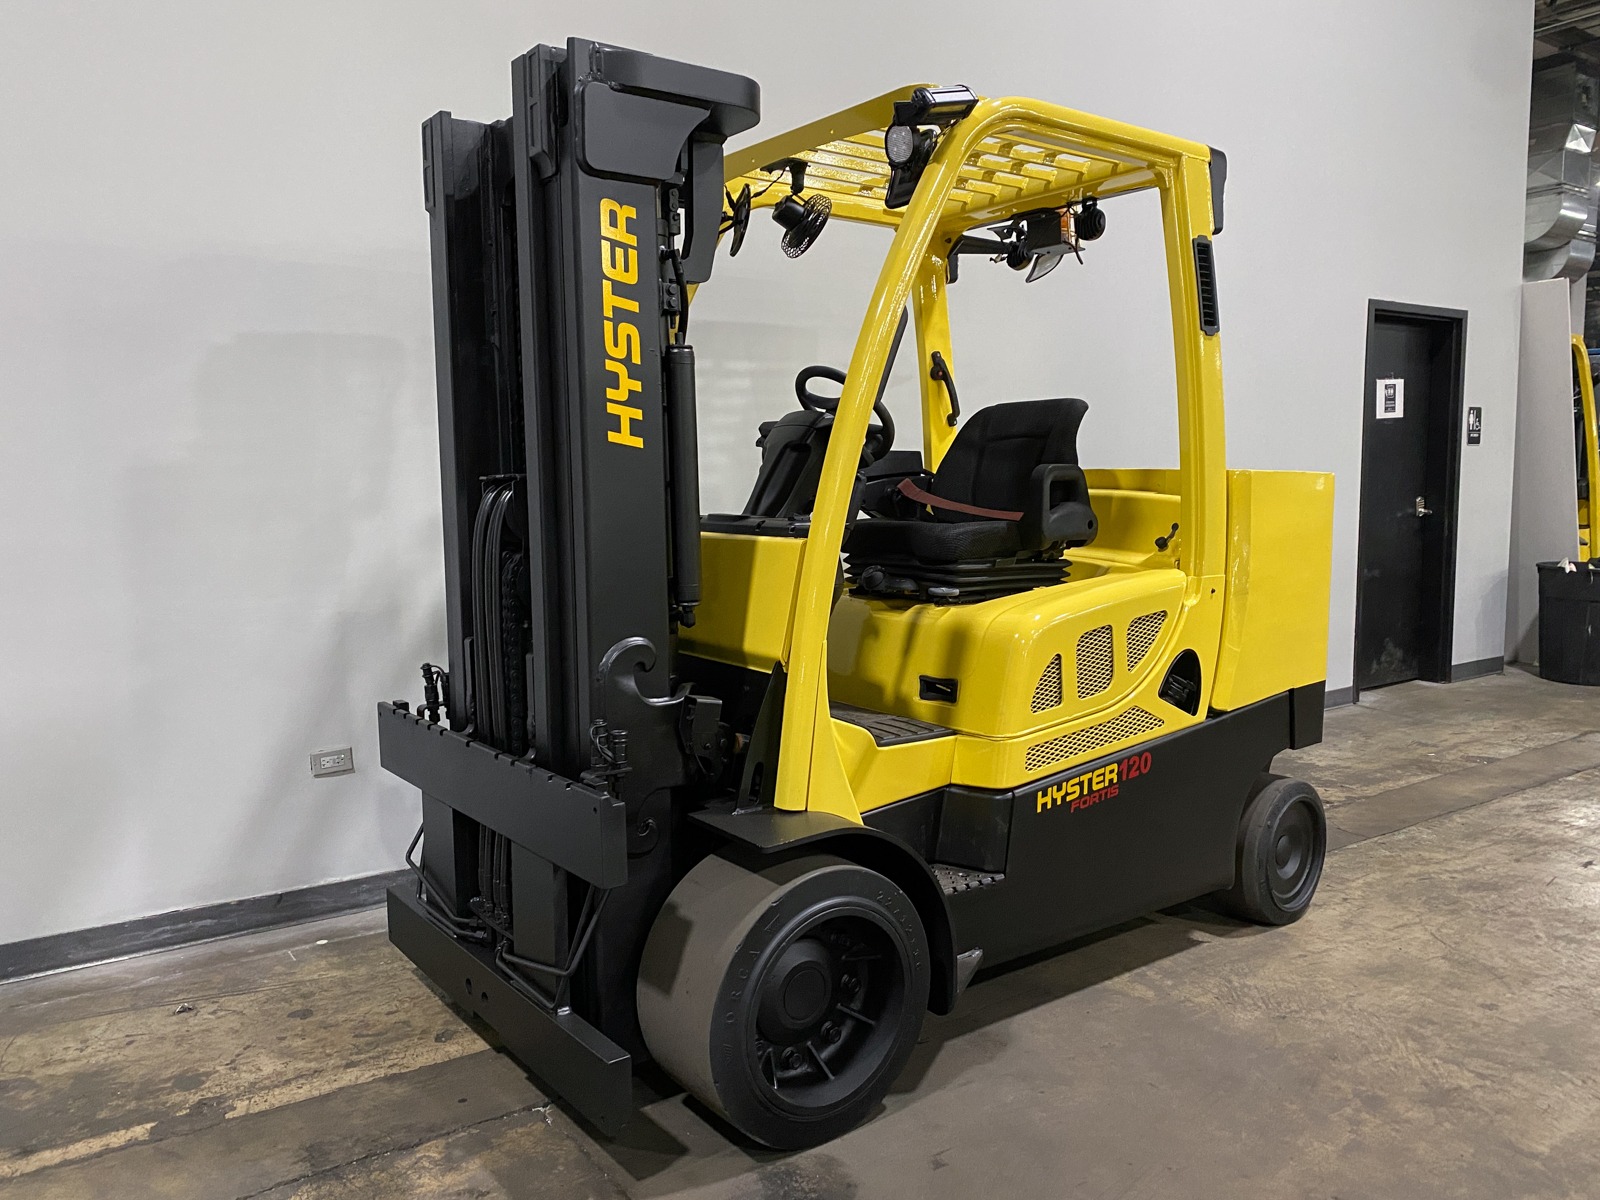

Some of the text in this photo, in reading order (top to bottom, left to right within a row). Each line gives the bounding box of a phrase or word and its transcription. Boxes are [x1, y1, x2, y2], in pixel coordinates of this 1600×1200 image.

[600, 197, 644, 449] HYSTER
[1037, 751, 1152, 813] HYSTER 120
[1070, 784, 1119, 813] FORTIS
